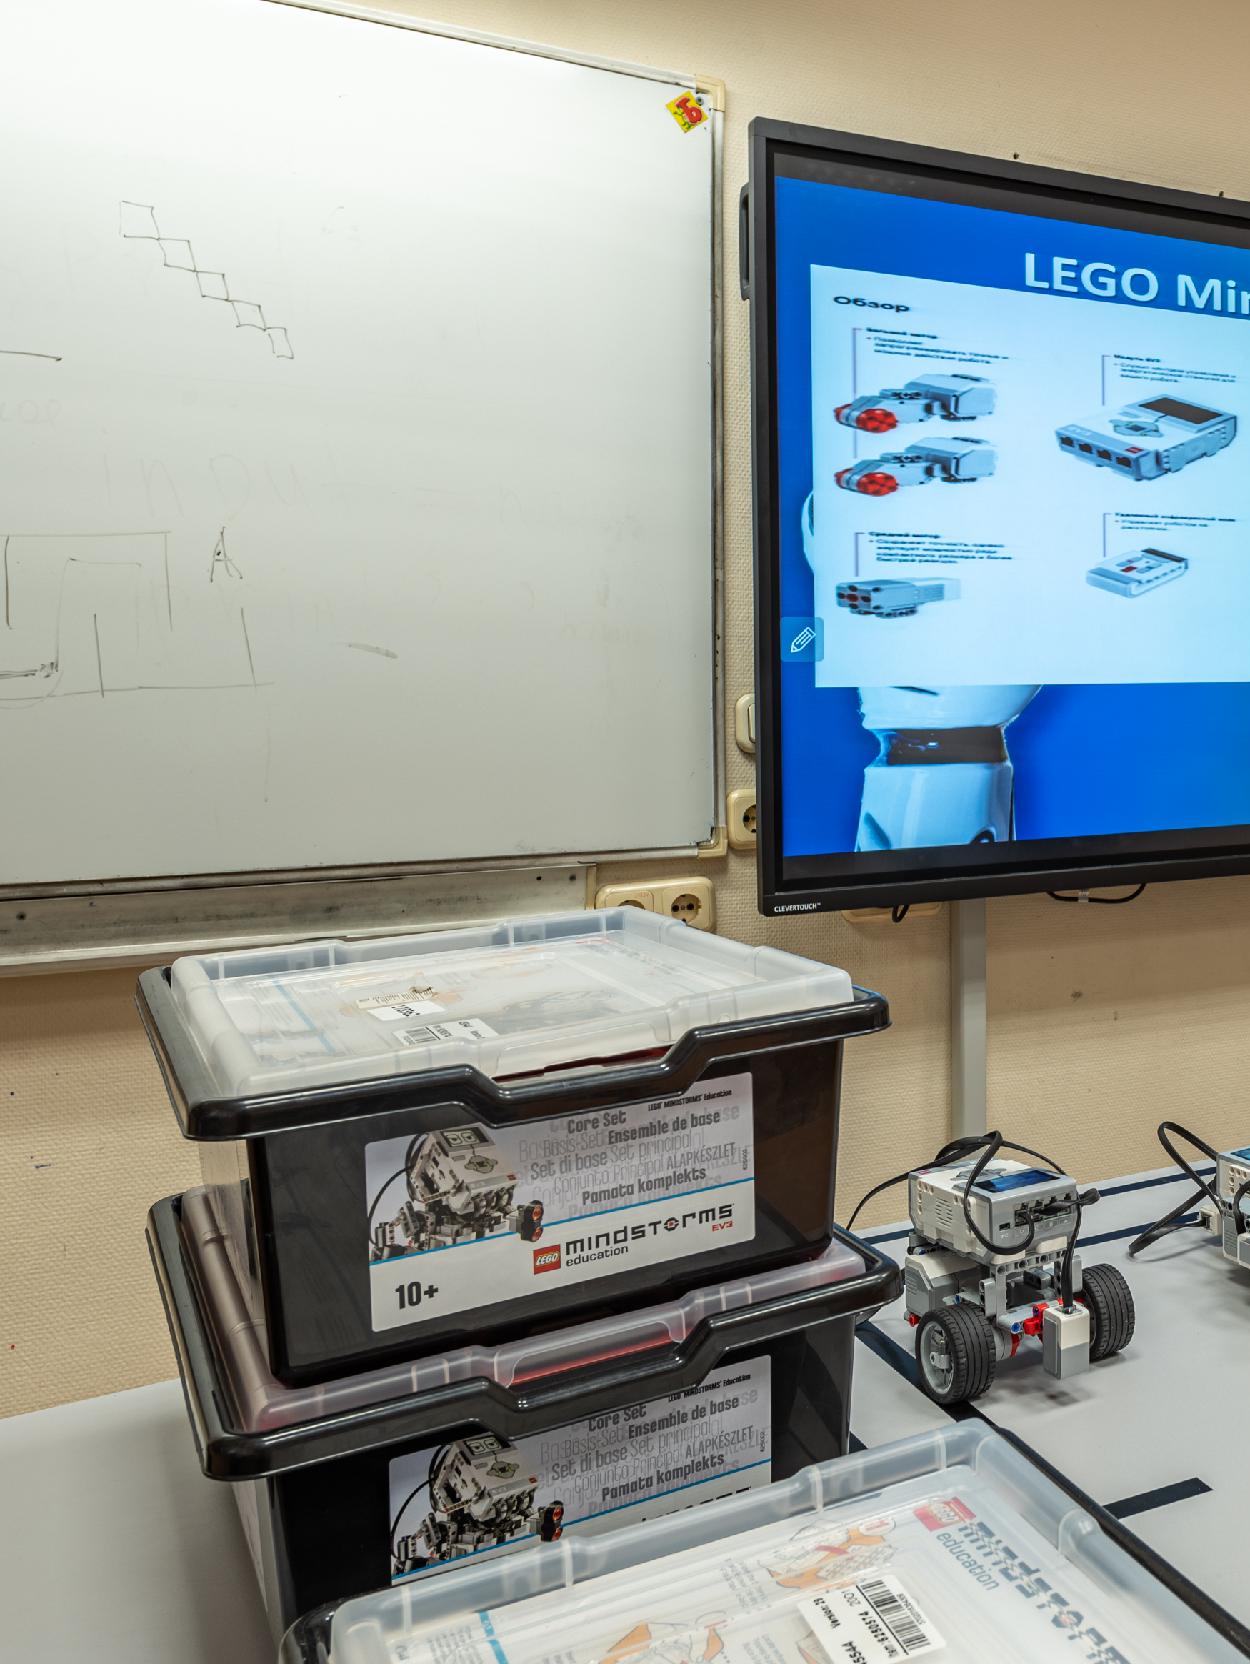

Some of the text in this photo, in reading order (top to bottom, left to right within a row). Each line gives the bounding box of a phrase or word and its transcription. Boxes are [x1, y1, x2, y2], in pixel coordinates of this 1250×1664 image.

[1024, 252, 1158, 302] LEGO
[833, 295, 910, 313] Обзор
[567, 1109, 627, 1134] Core Set
[608, 1109, 721, 1145] Ensemble de base
[531, 1149, 607, 1181] Set di base
[609, 1143, 635, 1164] Set
[666, 1142, 736, 1170] ALAPKÉSZLET
[582, 1166, 706, 1206] Pamata komplekts
[711, 1220, 733, 1232] EV3
[535, 1244, 629, 1267] LEGO education
[395, 1281, 439, 1309] 10+
[723, 1374, 751, 1387] Education
[588, 1404, 647, 1432] Core Set
[628, 1397, 739, 1440] Ensemble de base
[630, 1437, 655, 1457] Set
[685, 1424, 754, 1460] ALAPKÉSZLET
[552, 1445, 628, 1481] Set di base
[602, 1453, 725, 1501] Pamata komplekts
[935, 1531, 1001, 1591] education
